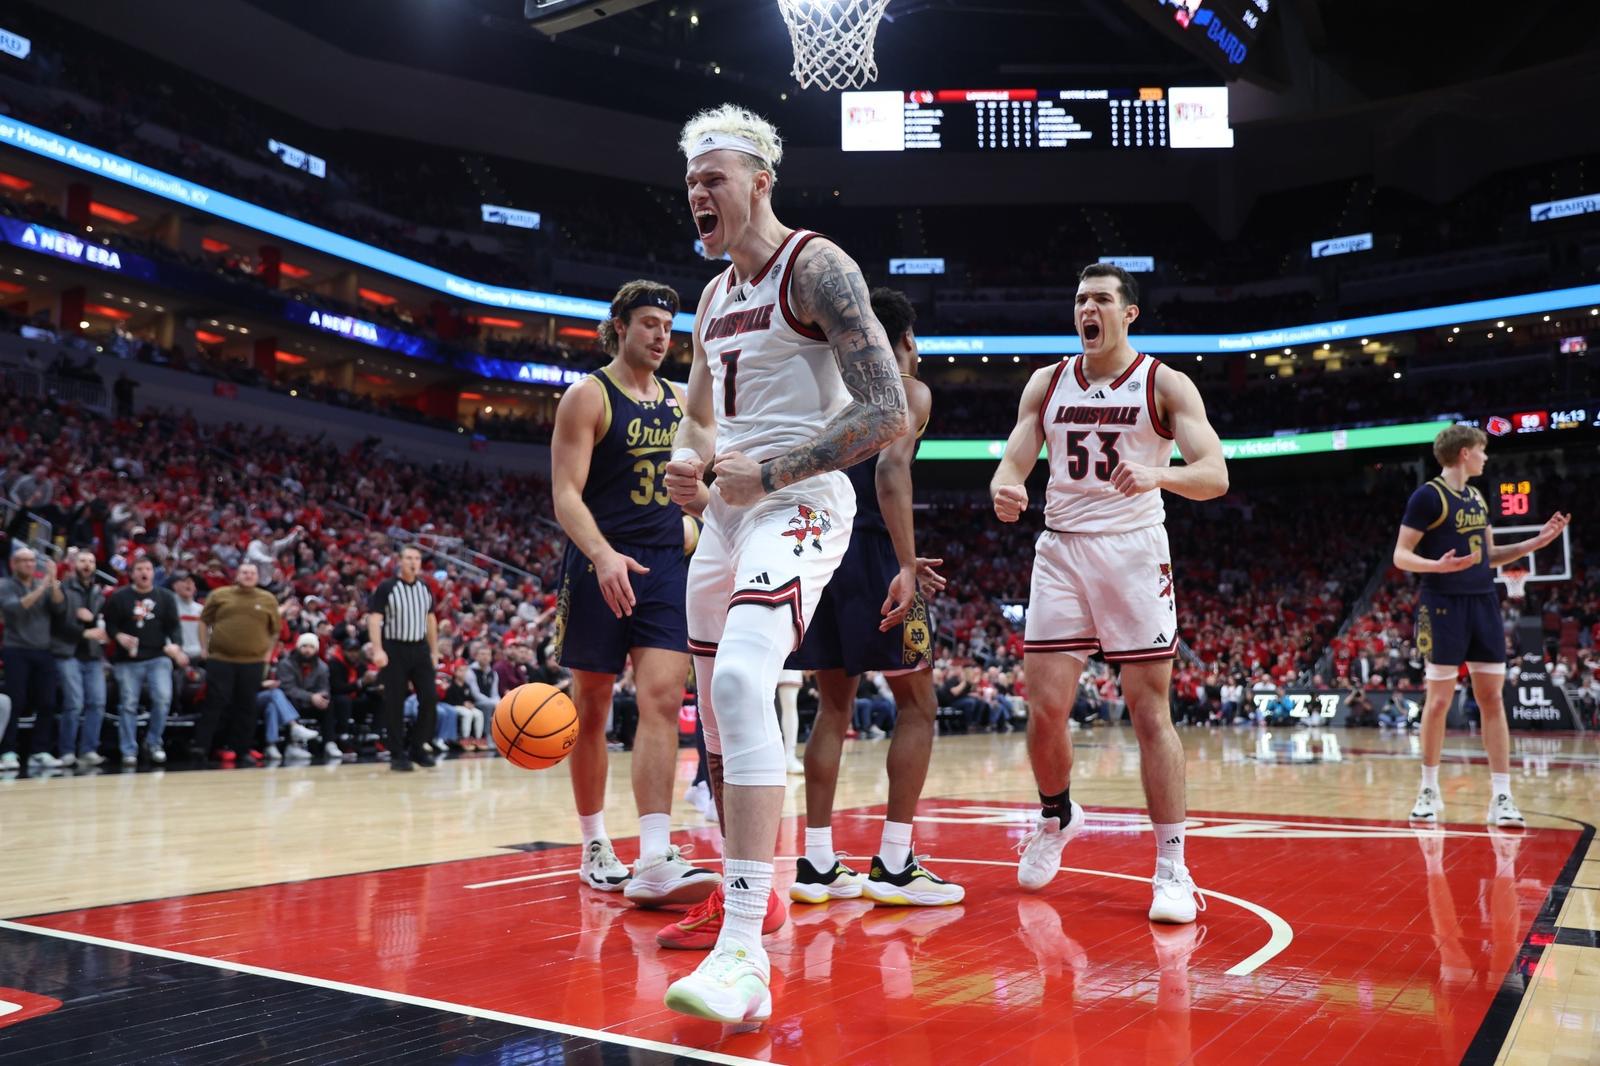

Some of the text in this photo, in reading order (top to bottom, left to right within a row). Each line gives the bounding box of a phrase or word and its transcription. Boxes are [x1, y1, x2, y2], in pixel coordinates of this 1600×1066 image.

[1207, 17, 1247, 64] BAIRD
[17, 127, 66, 157] Honda
[66, 145, 101, 169] Auto
[22, 227, 121, 269] A NEW ERA
[309, 311, 378, 342] A NEW ERA
[704, 303, 776, 343] LOUISVILLE
[519, 365, 530, 378] A
[531, 366, 562, 383] NEW
[719, 349, 742, 417] 1
[1053, 406, 1141, 425] LOUISVILLE
[1066, 431, 1121, 481] 53
[1501, 494, 1529, 516] 30
[1512, 706, 1561, 720] Health
[1518, 686, 1552, 706] UL
